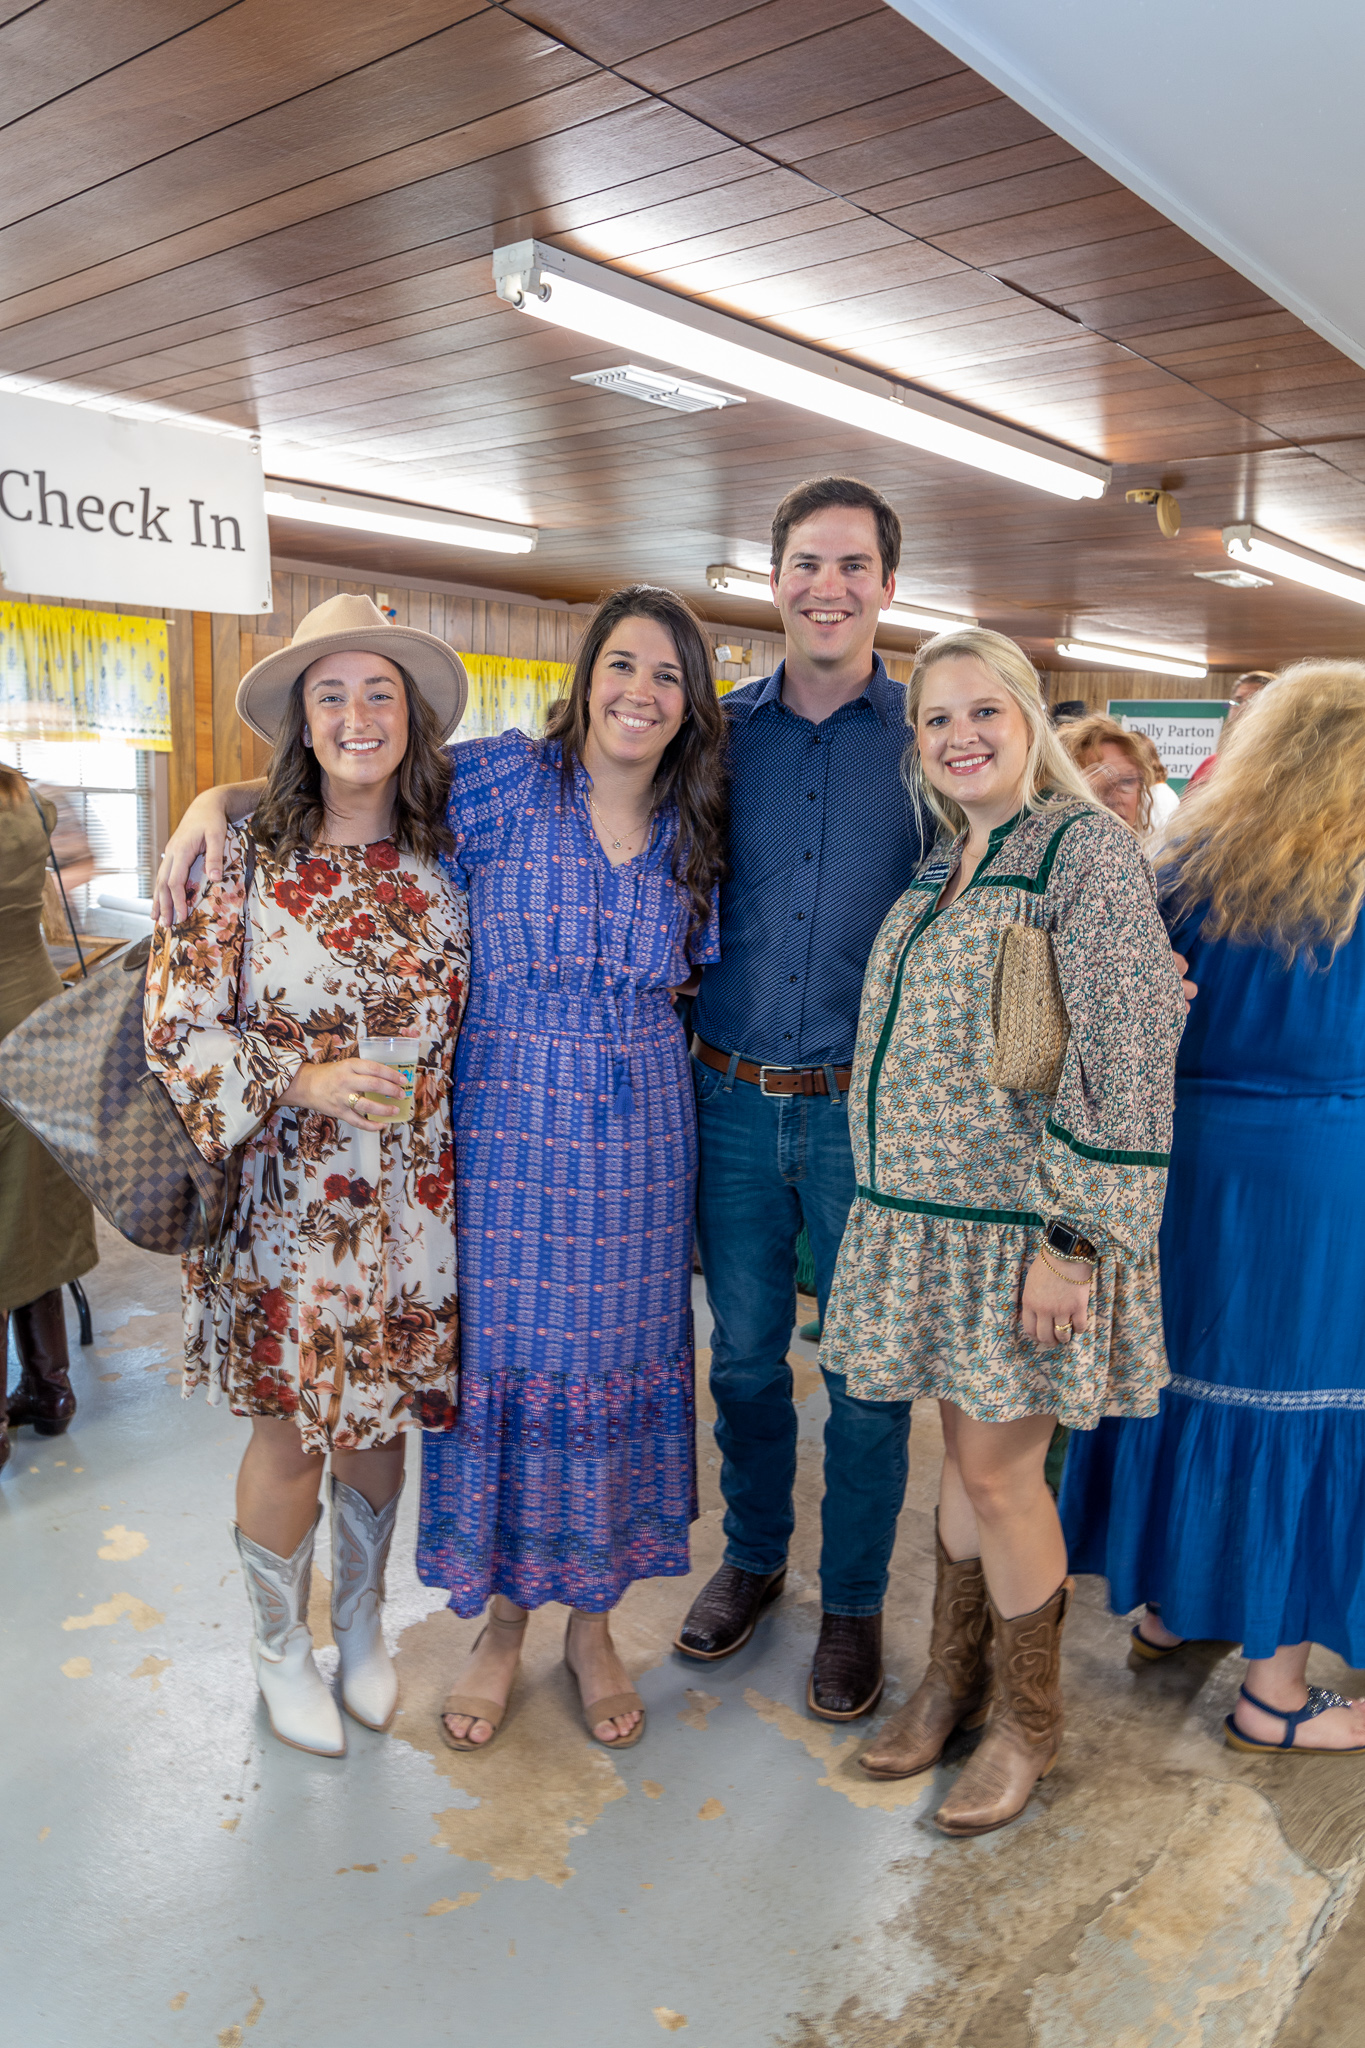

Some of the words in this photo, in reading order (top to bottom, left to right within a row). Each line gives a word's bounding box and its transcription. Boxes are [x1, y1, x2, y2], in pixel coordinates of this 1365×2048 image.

[0, 469, 172, 543] Check
[189, 499, 246, 552] In
[1168, 724, 1214, 738] Parton
[1156, 742, 1212, 757] gination
[1165, 763, 1193, 776] rary
